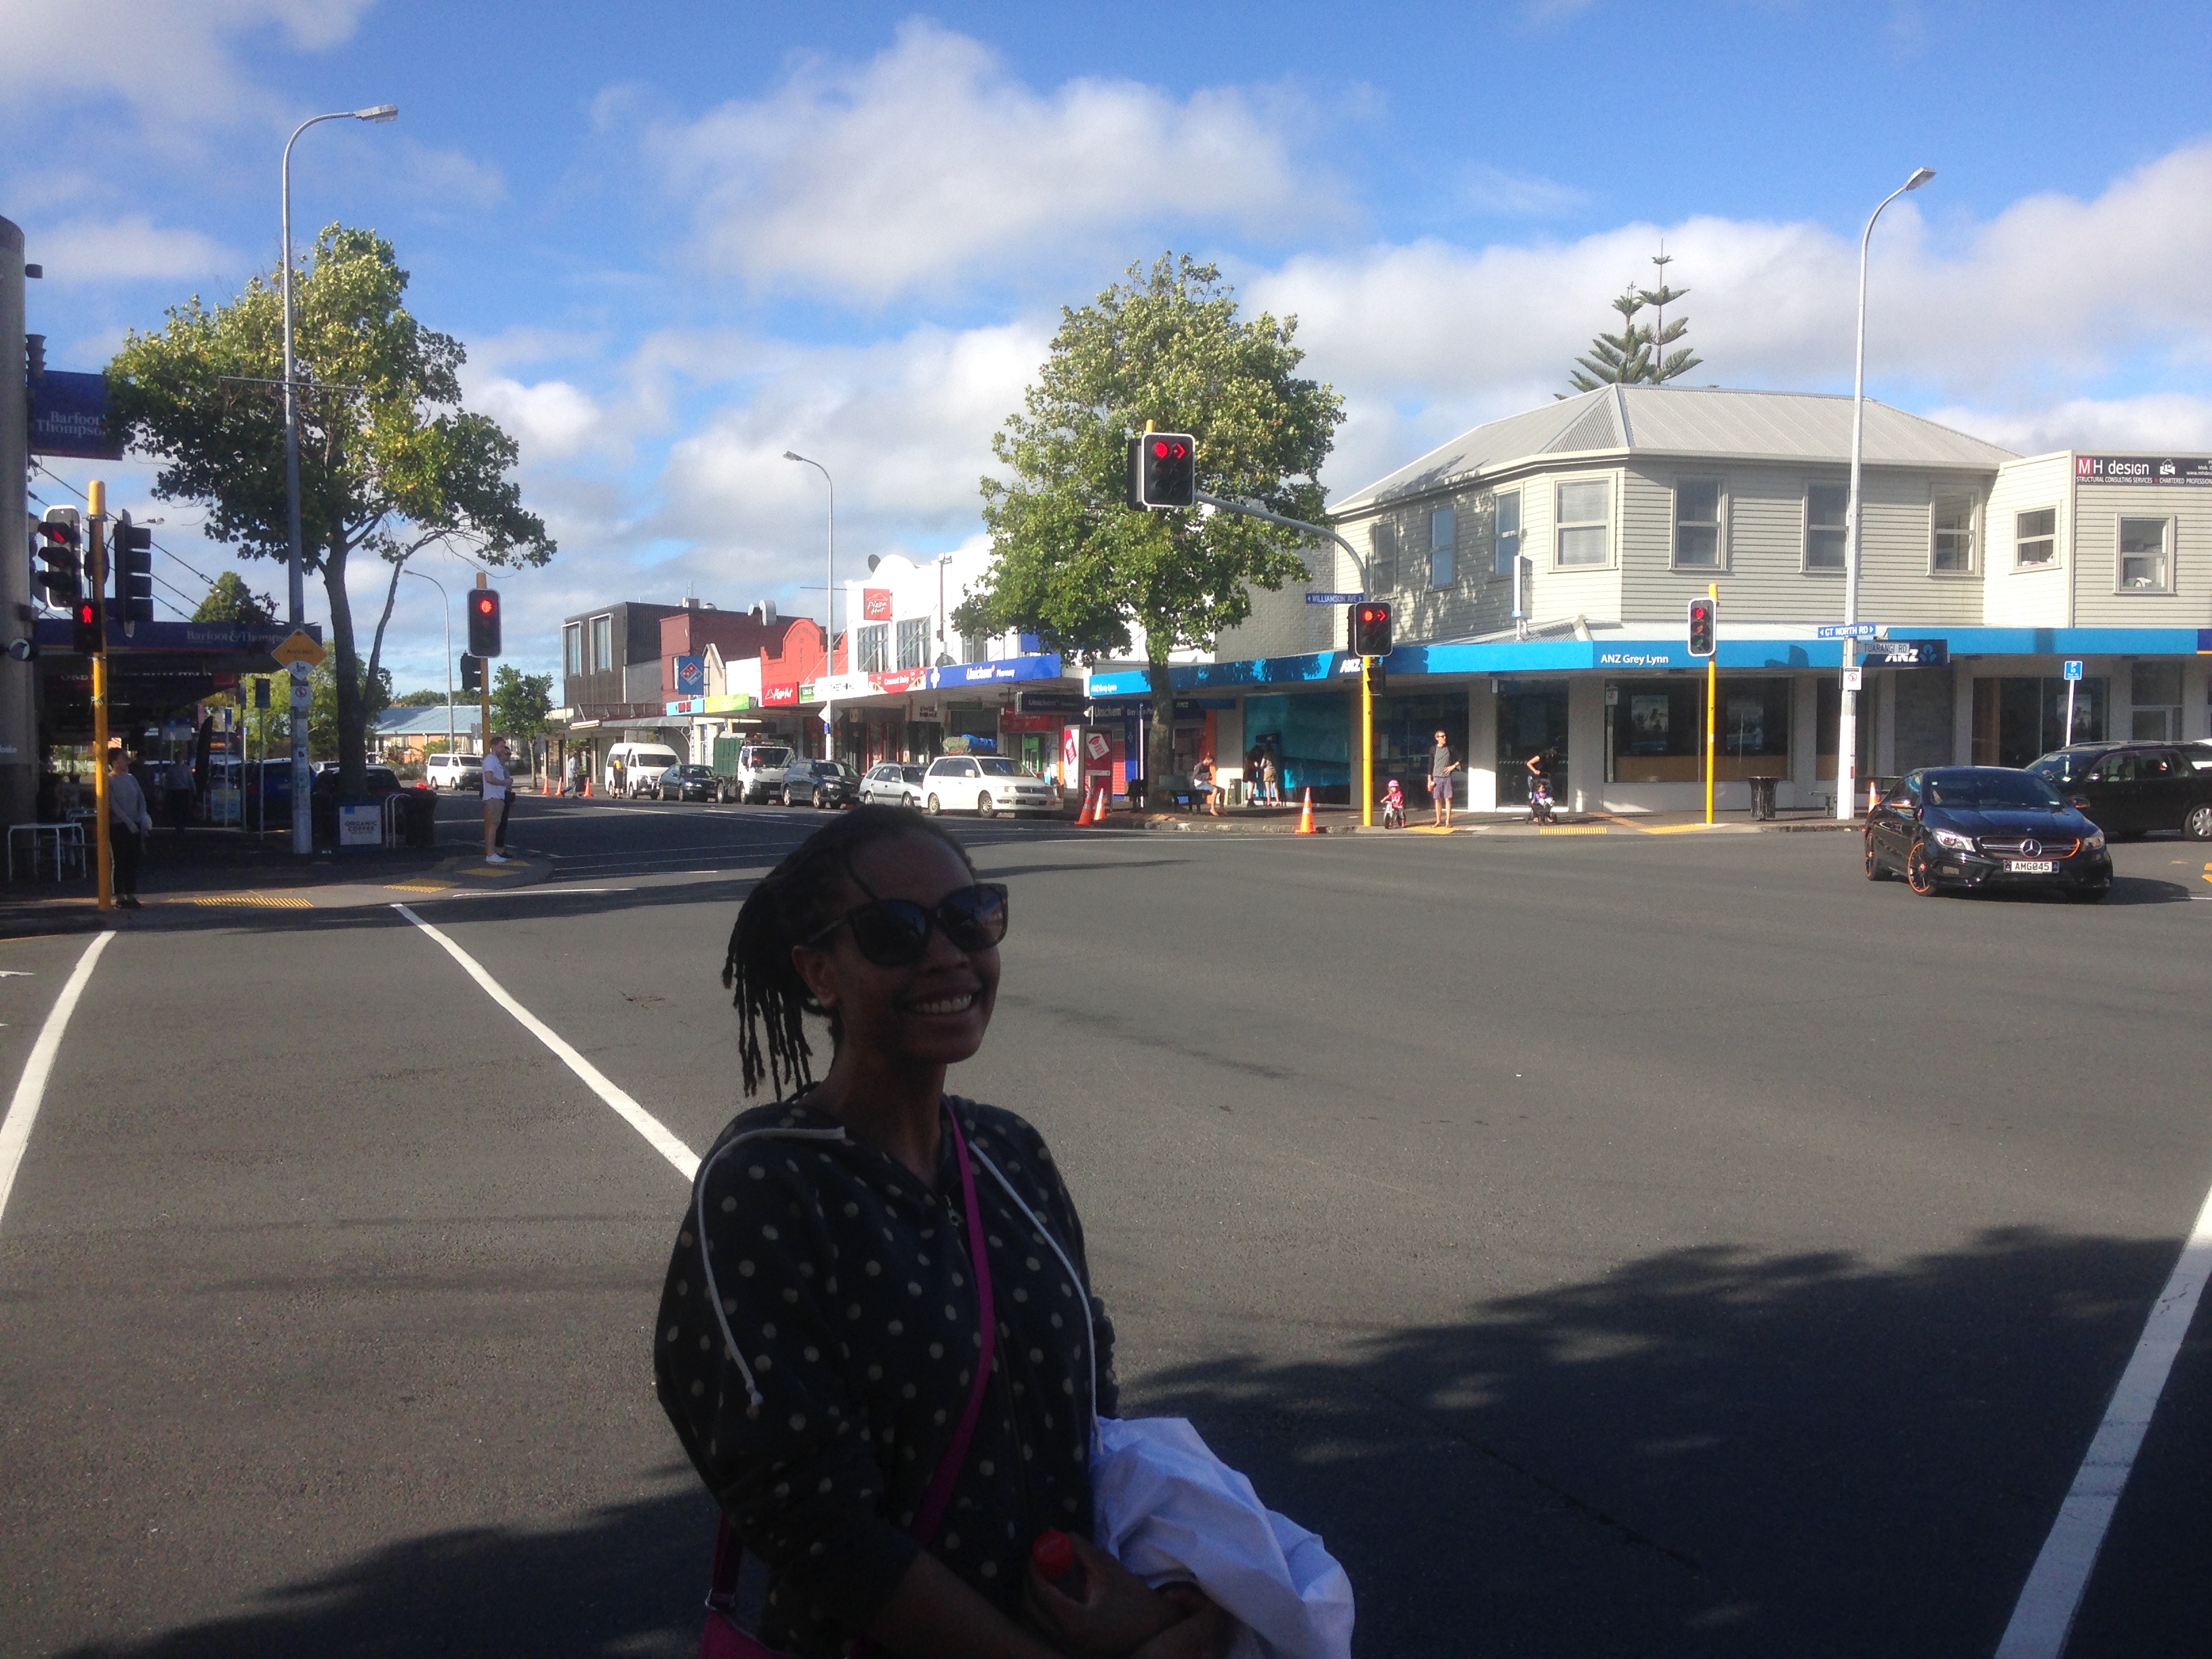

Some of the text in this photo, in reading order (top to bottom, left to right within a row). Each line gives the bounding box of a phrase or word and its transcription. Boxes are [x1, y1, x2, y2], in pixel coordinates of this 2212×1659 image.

[50, 411, 100, 426] Barfoot
[36, 419, 105, 438] Thompso
[2108, 459, 2150, 475] design
[867, 600, 887, 610] Pizza
[871, 607, 886, 615] Hut
[1824, 625, 1868, 636] GT NORTH RD
[186, 630, 228, 641] Barfoot
[240, 631, 287, 644] Thomps
[1864, 643, 1907, 653] TUARANGI RD
[1339, 658, 1361, 672] ANZ
[1601, 654, 1668, 665] ANZ Grey Lynn
[2014, 862, 2049, 871] AMG045
